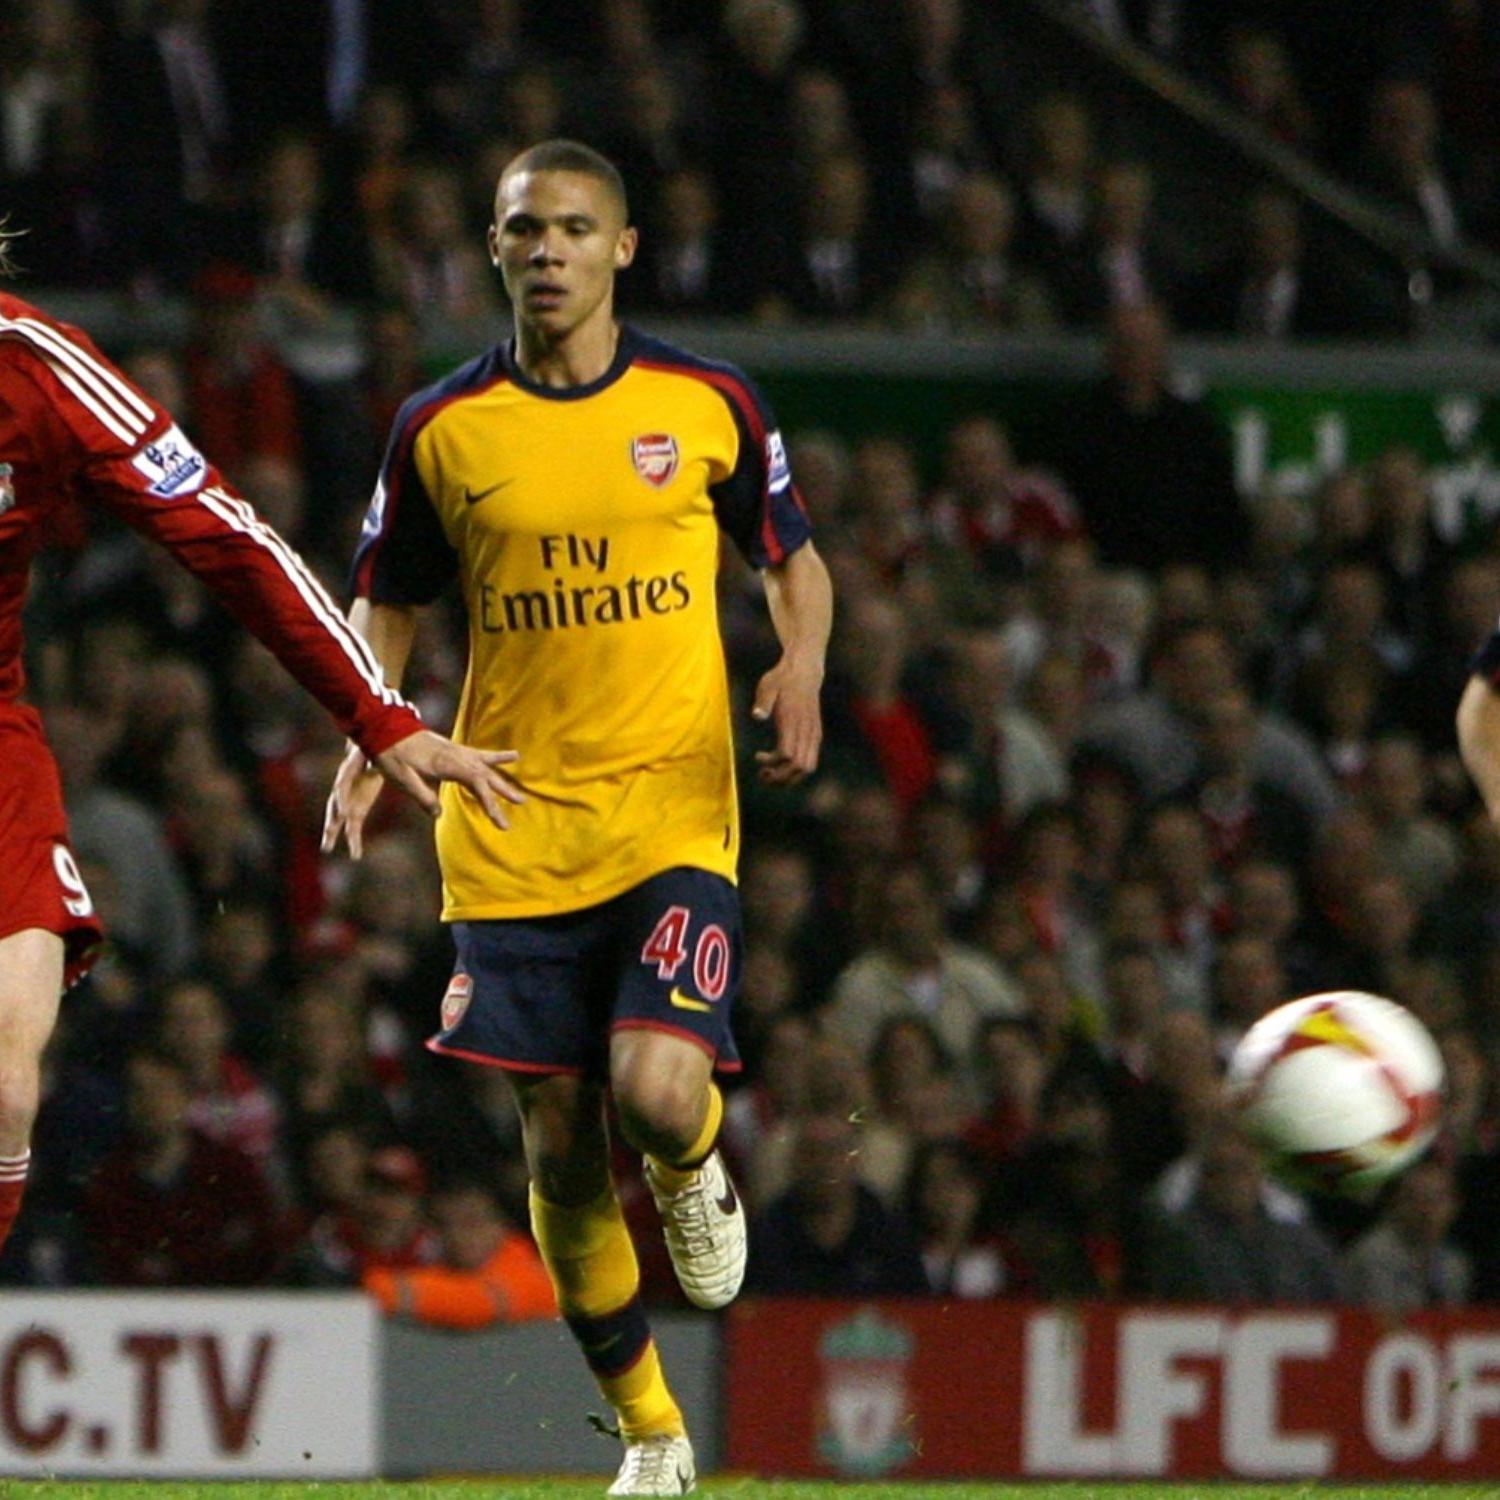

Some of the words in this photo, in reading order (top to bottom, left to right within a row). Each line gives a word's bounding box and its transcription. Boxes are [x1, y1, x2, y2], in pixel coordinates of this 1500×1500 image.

[541, 533, 609, 573] Fly
[480, 571, 690, 634] Emirates
[53, 844, 93, 917] 9
[641, 905, 729, 1001] 40
[1024, 1310, 1335, 1473] LFC
